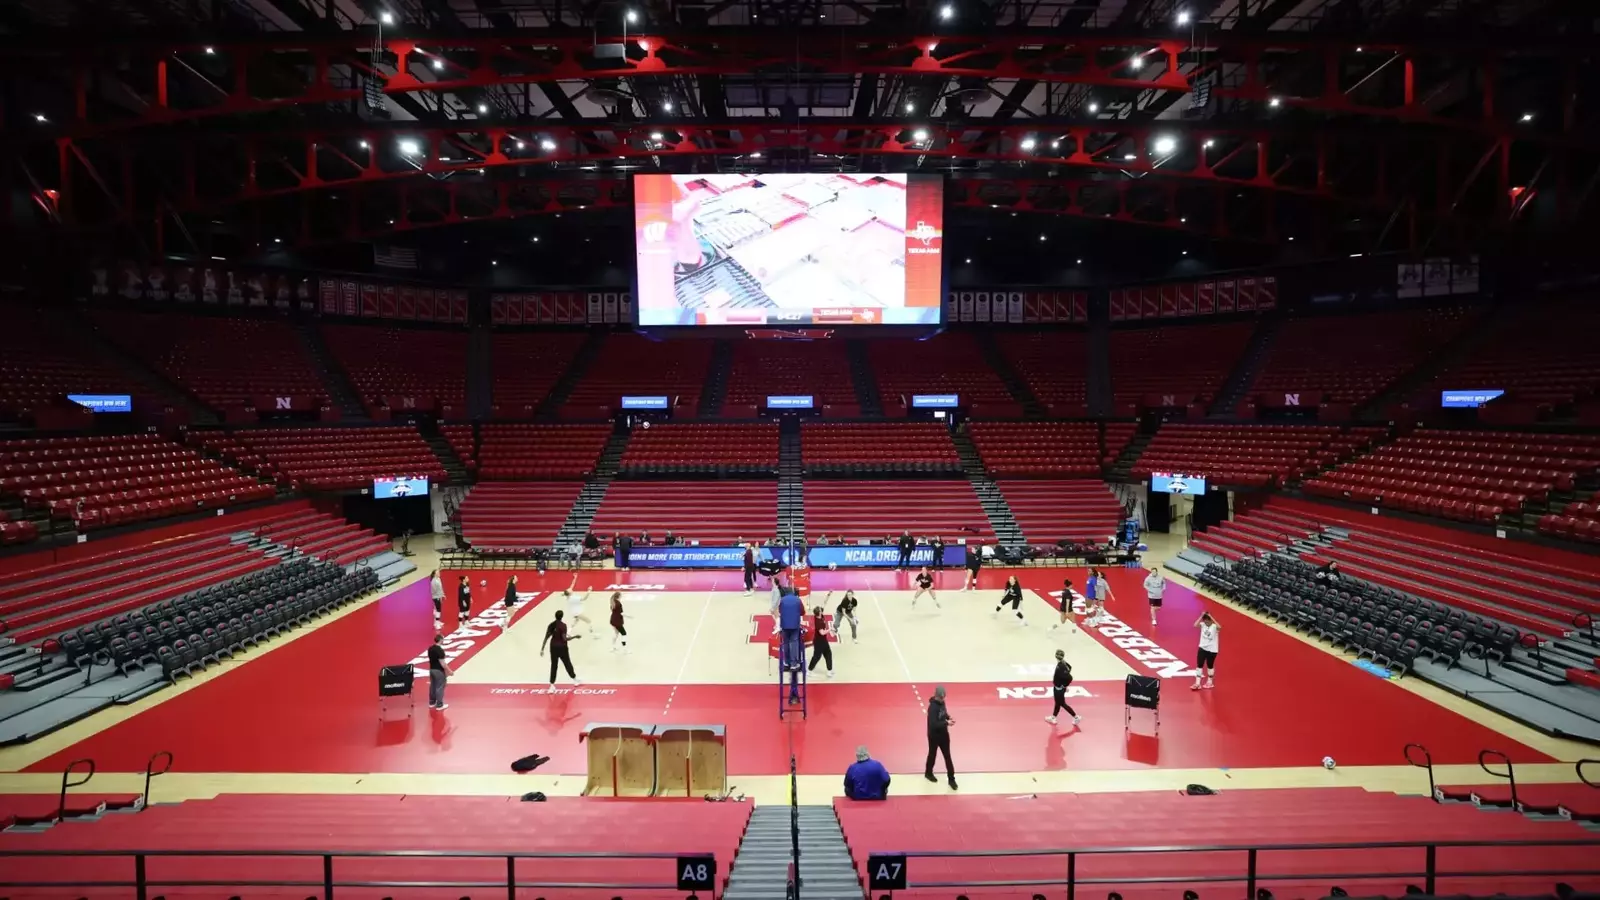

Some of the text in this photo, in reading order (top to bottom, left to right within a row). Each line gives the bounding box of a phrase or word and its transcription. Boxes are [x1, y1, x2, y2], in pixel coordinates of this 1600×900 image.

[276, 396, 292, 409] N
[403, 397, 416, 408] N
[1162, 395, 1175, 406] N
[1284, 393, 1300, 406] N
[628, 553, 745, 561] OING MORE FOR STUDENT-ATHLET
[844, 549, 934, 562] NCAA.ORG/HAN
[1129, 693, 1152, 702] molten
[681, 864, 708, 881] A8
[875, 863, 901, 881] A7
